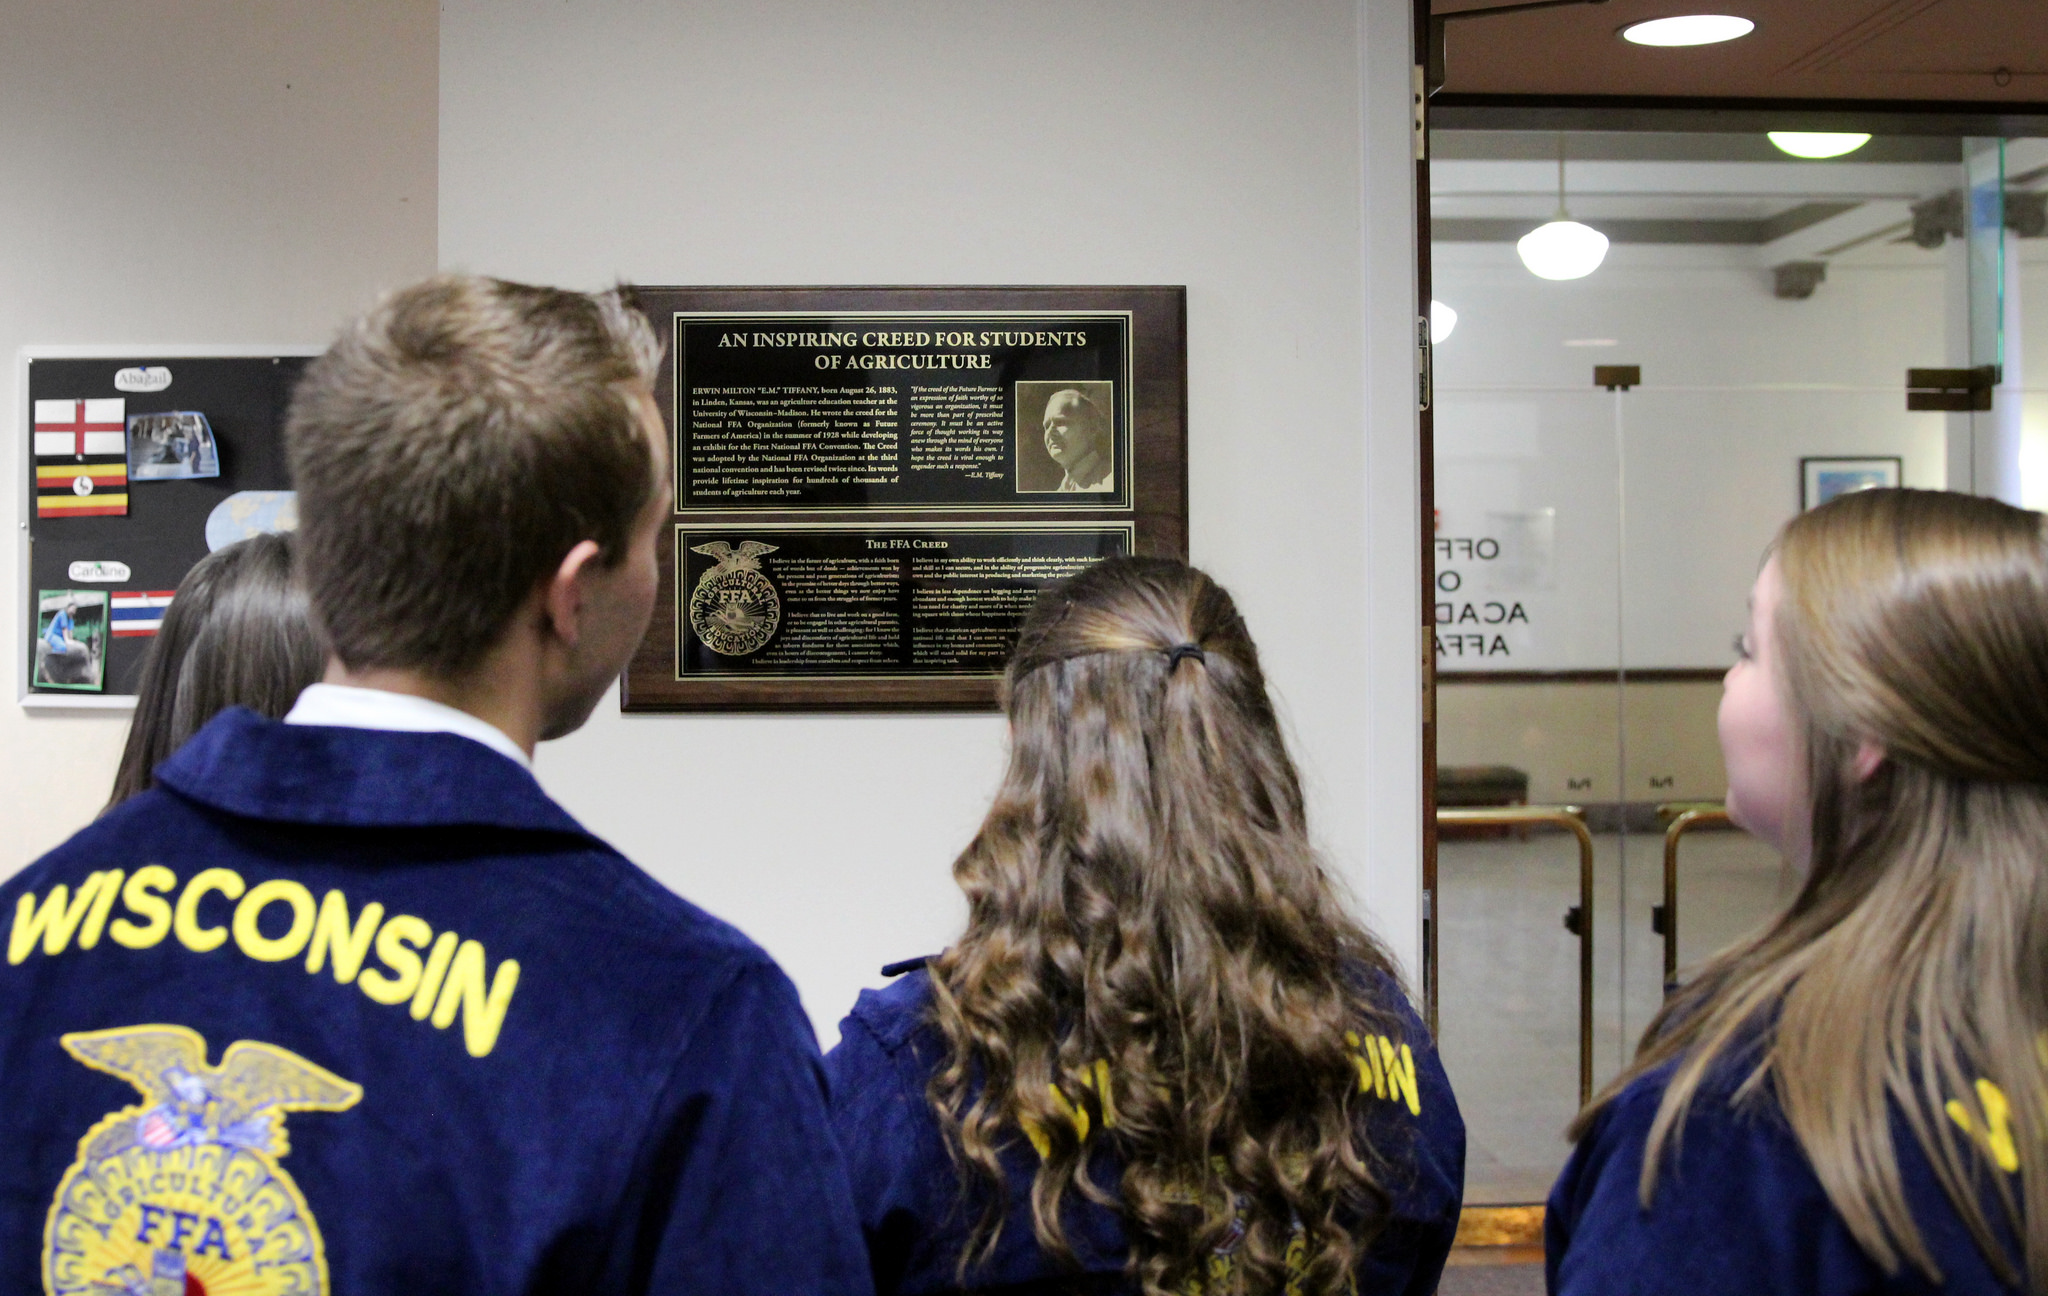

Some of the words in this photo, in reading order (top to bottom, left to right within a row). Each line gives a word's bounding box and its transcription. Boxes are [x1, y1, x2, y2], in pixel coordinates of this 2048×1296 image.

[718, 333, 748, 347] AN
[753, 332, 858, 347] INSPIRING
[862, 332, 931, 347] CREED
[935, 332, 977, 347] FOR
[980, 331, 1087, 347] STUDENTS
[814, 355, 842, 370] OF
[845, 354, 992, 369] AGRICULTURE
[693, 387, 720, 395] ERWIN
[723, 387, 755, 395] MILTON
[782, 387, 819, 395] TIFFANY,
[821, 386, 837, 394] born
[840, 386, 863, 396] August
[865, 386, 876, 395] 26,
[879, 386, 897, 395] 1883,
[701, 398, 727, 407] Linden,
[729, 398, 755, 407] Kansas,
[780, 398, 817, 407] agriculture
[818, 397, 851, 405] education
[853, 397, 877, 405] teacher
[878, 397, 885, 405] at
[886, 397, 897, 405] the
[693, 409, 727, 419] University
[729, 409, 737, 417] of
[811, 408, 821, 416] He
[822, 408, 841, 416] wrote
[843, 408, 854, 416] the
[855, 408, 874, 416] creed
[875, 408, 886, 416] for
[887, 408, 898, 416] the
[693, 420, 722, 428] National
[728, 420, 742, 428] FFA
[747, 420, 792, 430] Organization
[798, 420, 829, 430] (formerly
[875, 419, 898, 427] Future
[731, 431, 761, 440] America)
[772, 431, 783, 439] the
[813, 431, 822, 439] of
[823, 431, 839, 439] 1928
[861, 430, 898, 440] developing
[703, 443, 726, 451] exhibit
[771, 442, 800, 450] National
[802, 442, 816, 450] FFA
[819, 442, 860, 450] Convention.
[707, 454, 735, 464] adopted
[737, 454, 746, 463] by
[762, 453, 791, 461] National
[794, 453, 808, 461] FFA
[811, 453, 855, 463] Organization
[858, 453, 865, 461] at
[693, 465, 720, 473] national
[722, 465, 759, 473] convention
[804, 464, 827, 472] revised
[828, 464, 846, 472] twice
[848, 464, 867, 472] since.
[868, 464, 877, 472] Its
[877, 464, 898, 472] words
[693, 476, 718, 486] provide
[722, 476, 748, 484] lifetime
[752, 476, 789, 486] inspiration
[842, 475, 850, 483] of
[853, 475, 887, 483] thousands
[890, 475, 899, 483] of
[693, 488, 721, 496] students
[730, 488, 768, 497] agriculture
[769, 487, 784, 495] each
[890, 540, 911, 549] FFA
[719, 590, 754, 603] FFA
[7, 864, 520, 1058] WISCONSIN
[136, 1203, 234, 1262] FFA
